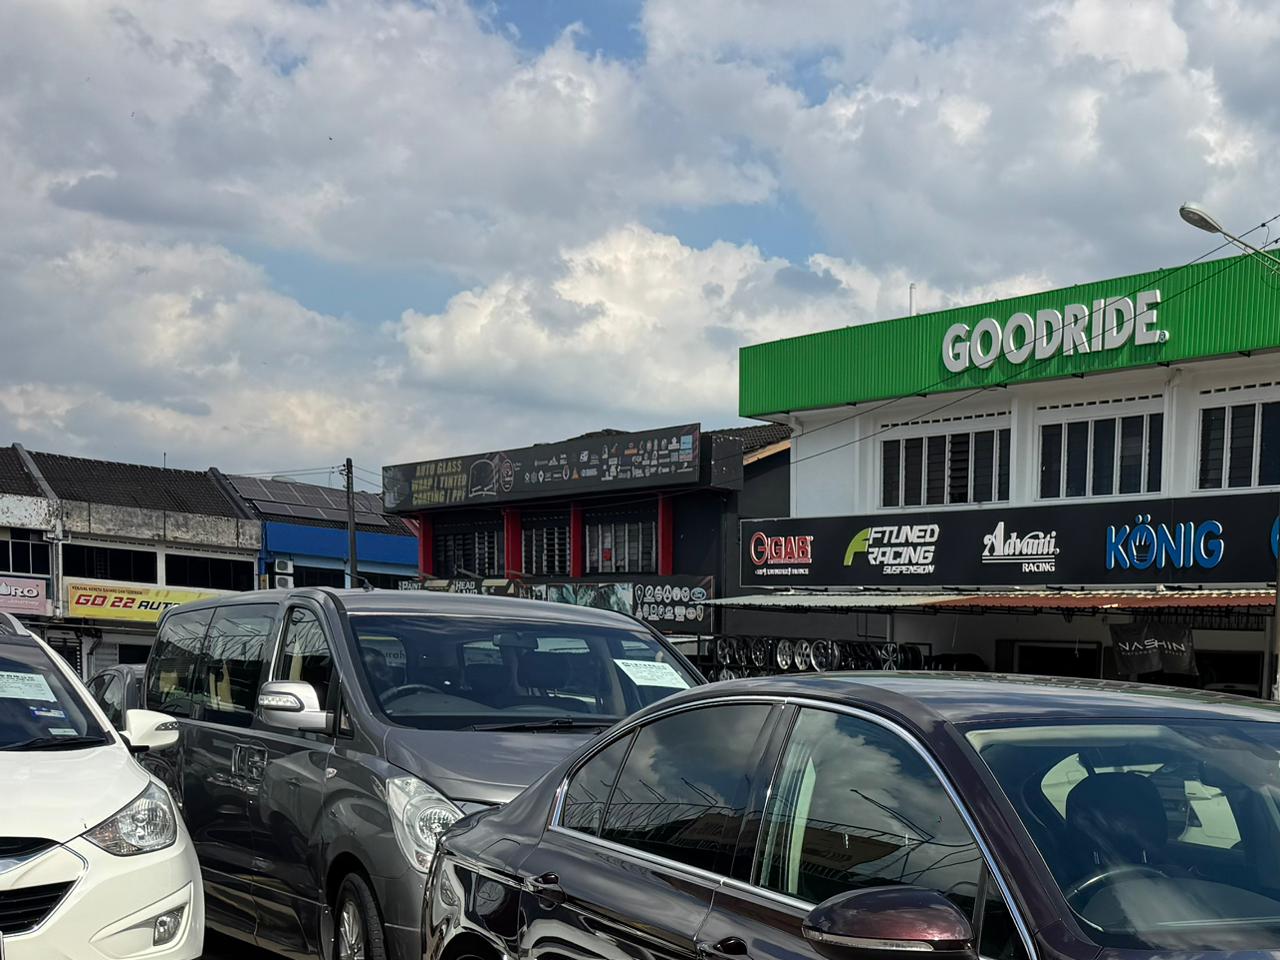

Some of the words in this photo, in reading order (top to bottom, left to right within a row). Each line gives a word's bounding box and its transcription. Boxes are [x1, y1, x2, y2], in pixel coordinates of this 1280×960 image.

[942, 289, 1161, 373] GOODRIDE
[437, 460, 463, 474] GLASS
[982, 521, 1057, 557] Advanti
[1106, 514, 1225, 570] KÖNIG
[867, 545, 936, 565] RACING
[882, 564, 935, 575] SUSPENSION
[1022, 562, 1055, 573] RACING
[455, 580, 476, 590] HEAD
[75, 594, 108, 606] GO
[110, 596, 136, 608] 22
[137, 600, 180, 610] AUT
